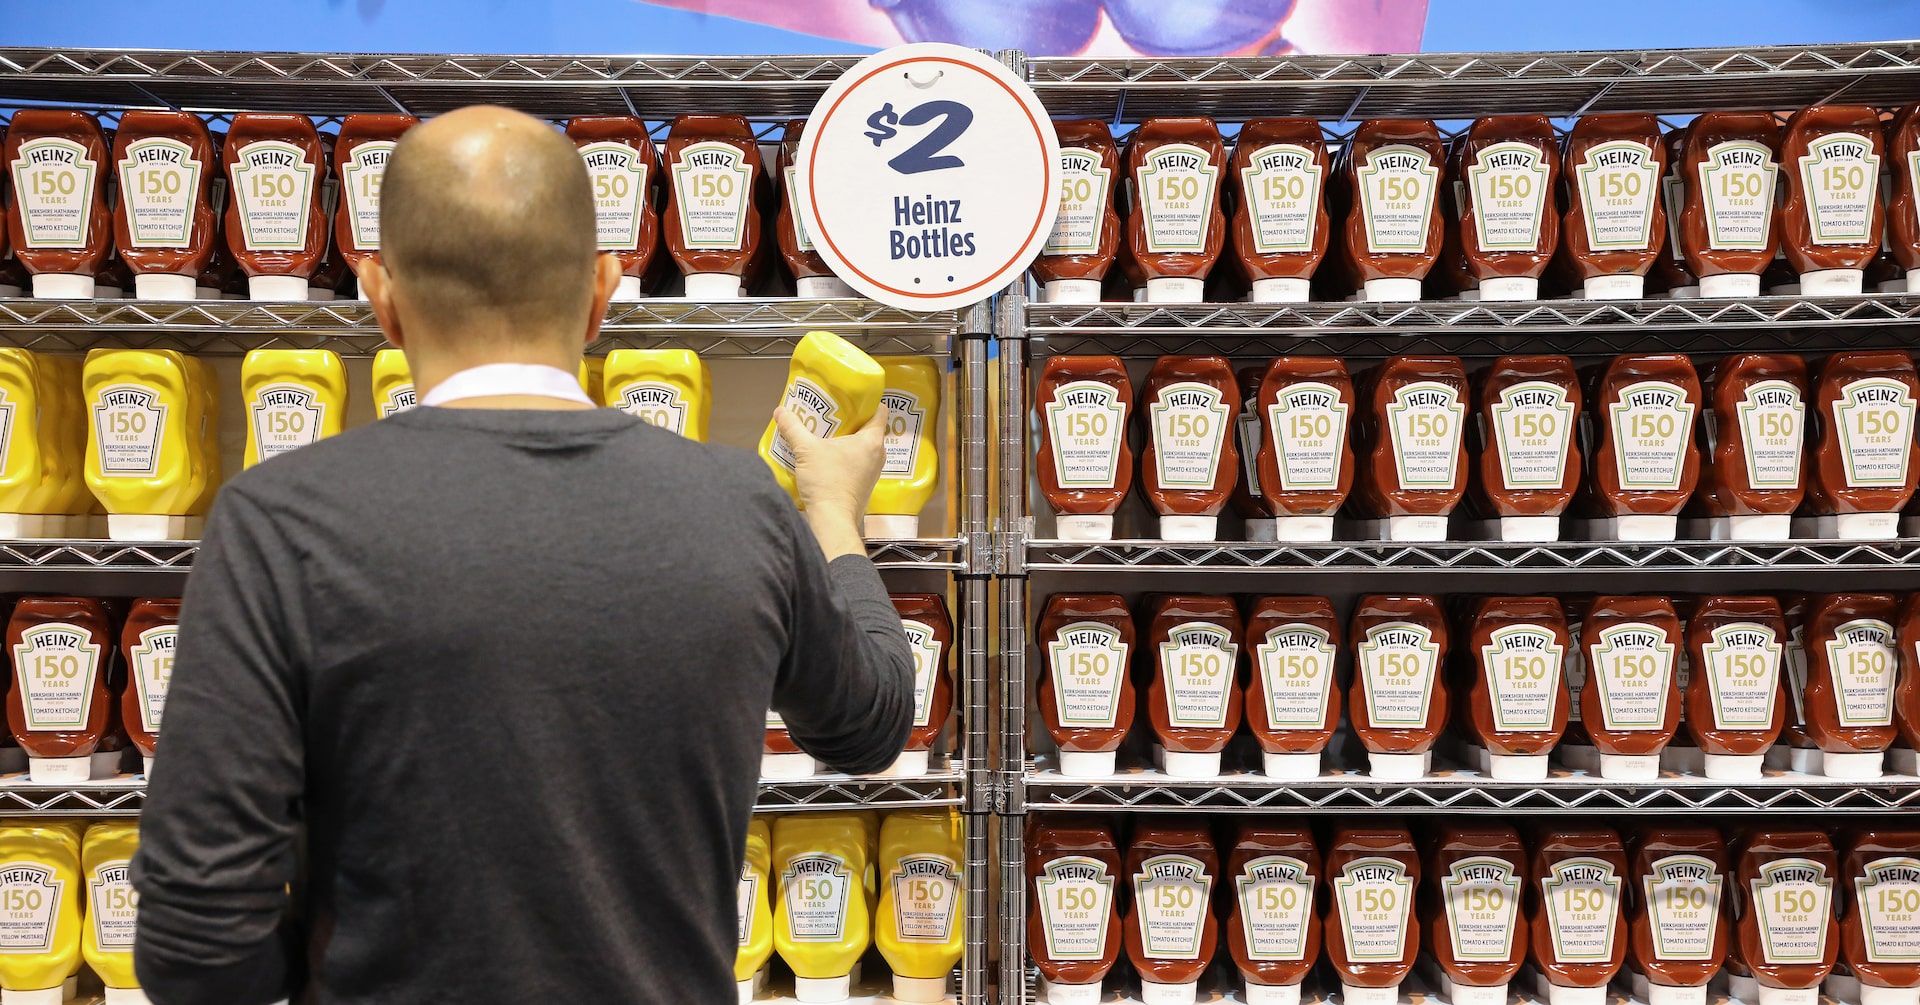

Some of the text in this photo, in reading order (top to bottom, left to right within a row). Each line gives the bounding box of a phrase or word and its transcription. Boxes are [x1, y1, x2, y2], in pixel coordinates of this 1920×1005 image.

[864, 100, 974, 174] $2
[32, 150, 73, 163] HEINZ
[139, 149, 179, 163] HEINZ
[252, 153, 292, 166] HEINZ
[587, 154, 626, 167] HEINZ
[693, 154, 732, 167] HEINZ
[1599, 152, 1640, 166] HEINZ
[1722, 152, 1761, 165] HEINZ
[1823, 145, 1862, 159] HEINZ
[1062, 158, 1090, 171] EINZ
[1158, 156, 1198, 169] HEINZ
[1263, 156, 1302, 169] HEINZ
[1380, 156, 1419, 170] HEINZ
[1490, 154, 1530, 168] HEINZ
[32, 172, 74, 194] 150
[139, 171, 180, 194] 150
[252, 174, 295, 198] 150
[362, 174, 382, 198] 15
[694, 174, 733, 198] 150
[1600, 173, 1641, 197] 150
[1722, 173, 1762, 197] 150
[1824, 166, 1864, 190] 150
[1062, 178, 1091, 202] 50
[1158, 176, 1198, 200] 150
[1264, 176, 1304, 200] 150
[1380, 178, 1420, 200] 150
[1490, 175, 1531, 199] 150
[894, 194, 962, 226] Heinz
[890, 228, 976, 260] Bottles
[110, 392, 146, 406] HEINZ
[268, 394, 304, 406] HEINZ
[632, 391, 668, 404] HEINZ
[798, 388, 825, 413] HEINZ
[881, 398, 906, 411] EINZ
[1068, 392, 1106, 406] HEINZ
[1170, 394, 1209, 407] HEINZ
[1290, 394, 1329, 408] HEINZ
[1408, 393, 1446, 406] HEINZ
[1514, 393, 1554, 406] HEINZ
[1632, 394, 1674, 407] HEINZ
[1758, 392, 1792, 406] HEINZ
[1857, 390, 1898, 403] HEINZ
[110, 411, 146, 434] 150
[268, 411, 304, 433] 150
[1068, 413, 1108, 436] 150
[1170, 414, 1209, 438] 150
[1292, 415, 1330, 438] 150
[1409, 414, 1448, 437] 150
[1514, 414, 1556, 438] 150
[1632, 414, 1674, 438] 150
[1759, 413, 1793, 436] 150
[1858, 412, 1899, 434] 150
[116, 434, 139, 442] YEARS
[35, 635, 77, 648] HEINZ
[154, 637, 176, 650] HEI
[1070, 633, 1108, 646] HEINZ
[1182, 634, 1220, 647] HEINZ
[1279, 635, 1318, 648] HEINZ
[1380, 633, 1418, 646] HEINZ
[1505, 636, 1544, 649] HEINZ
[1614, 634, 1654, 648] HEINZ
[1726, 634, 1764, 647] HEINZ
[1848, 630, 1884, 644] HEINZ
[35, 656, 78, 679] 150
[152, 657, 174, 681] 15
[1070, 653, 1109, 676] 150
[1181, 654, 1220, 679] 150
[1280, 656, 1318, 678] 150
[1380, 653, 1420, 677] 150
[1505, 656, 1546, 680] 150
[1615, 655, 1656, 679] 150
[1726, 654, 1766, 678] 150
[1848, 651, 1886, 675] 150
[797, 862, 832, 874] HEINZ
[910, 863, 945, 876] HEINZ
[1057, 868, 1096, 881] HEINZ
[1154, 865, 1193, 879] HEINZ
[1257, 868, 1296, 880] HEINZ
[1356, 868, 1394, 882] HEINZ
[1463, 868, 1502, 881] HEINZ
[1564, 868, 1602, 882] HEINZ
[1666, 866, 1705, 879] HEINZ
[1774, 870, 1814, 883] HEINZ
[1878, 869, 1919, 882] HEINZ
[4, 871, 42, 884] HEINZ
[798, 880, 833, 900] 150
[908, 880, 944, 901] 150
[1154, 885, 1194, 908] 150
[1666, 886, 1706, 910] 150
[4, 889, 42, 910] 150
[914, 902, 936, 910] YEARS
[1057, 887, 1097, 912] 150
[1256, 887, 1296, 912] 150
[1356, 888, 1396, 912] 150
[1464, 888, 1504, 911] 150
[1564, 888, 1604, 912] 150
[1774, 891, 1816, 913] 150
[1878, 889, 1920, 913] 150
